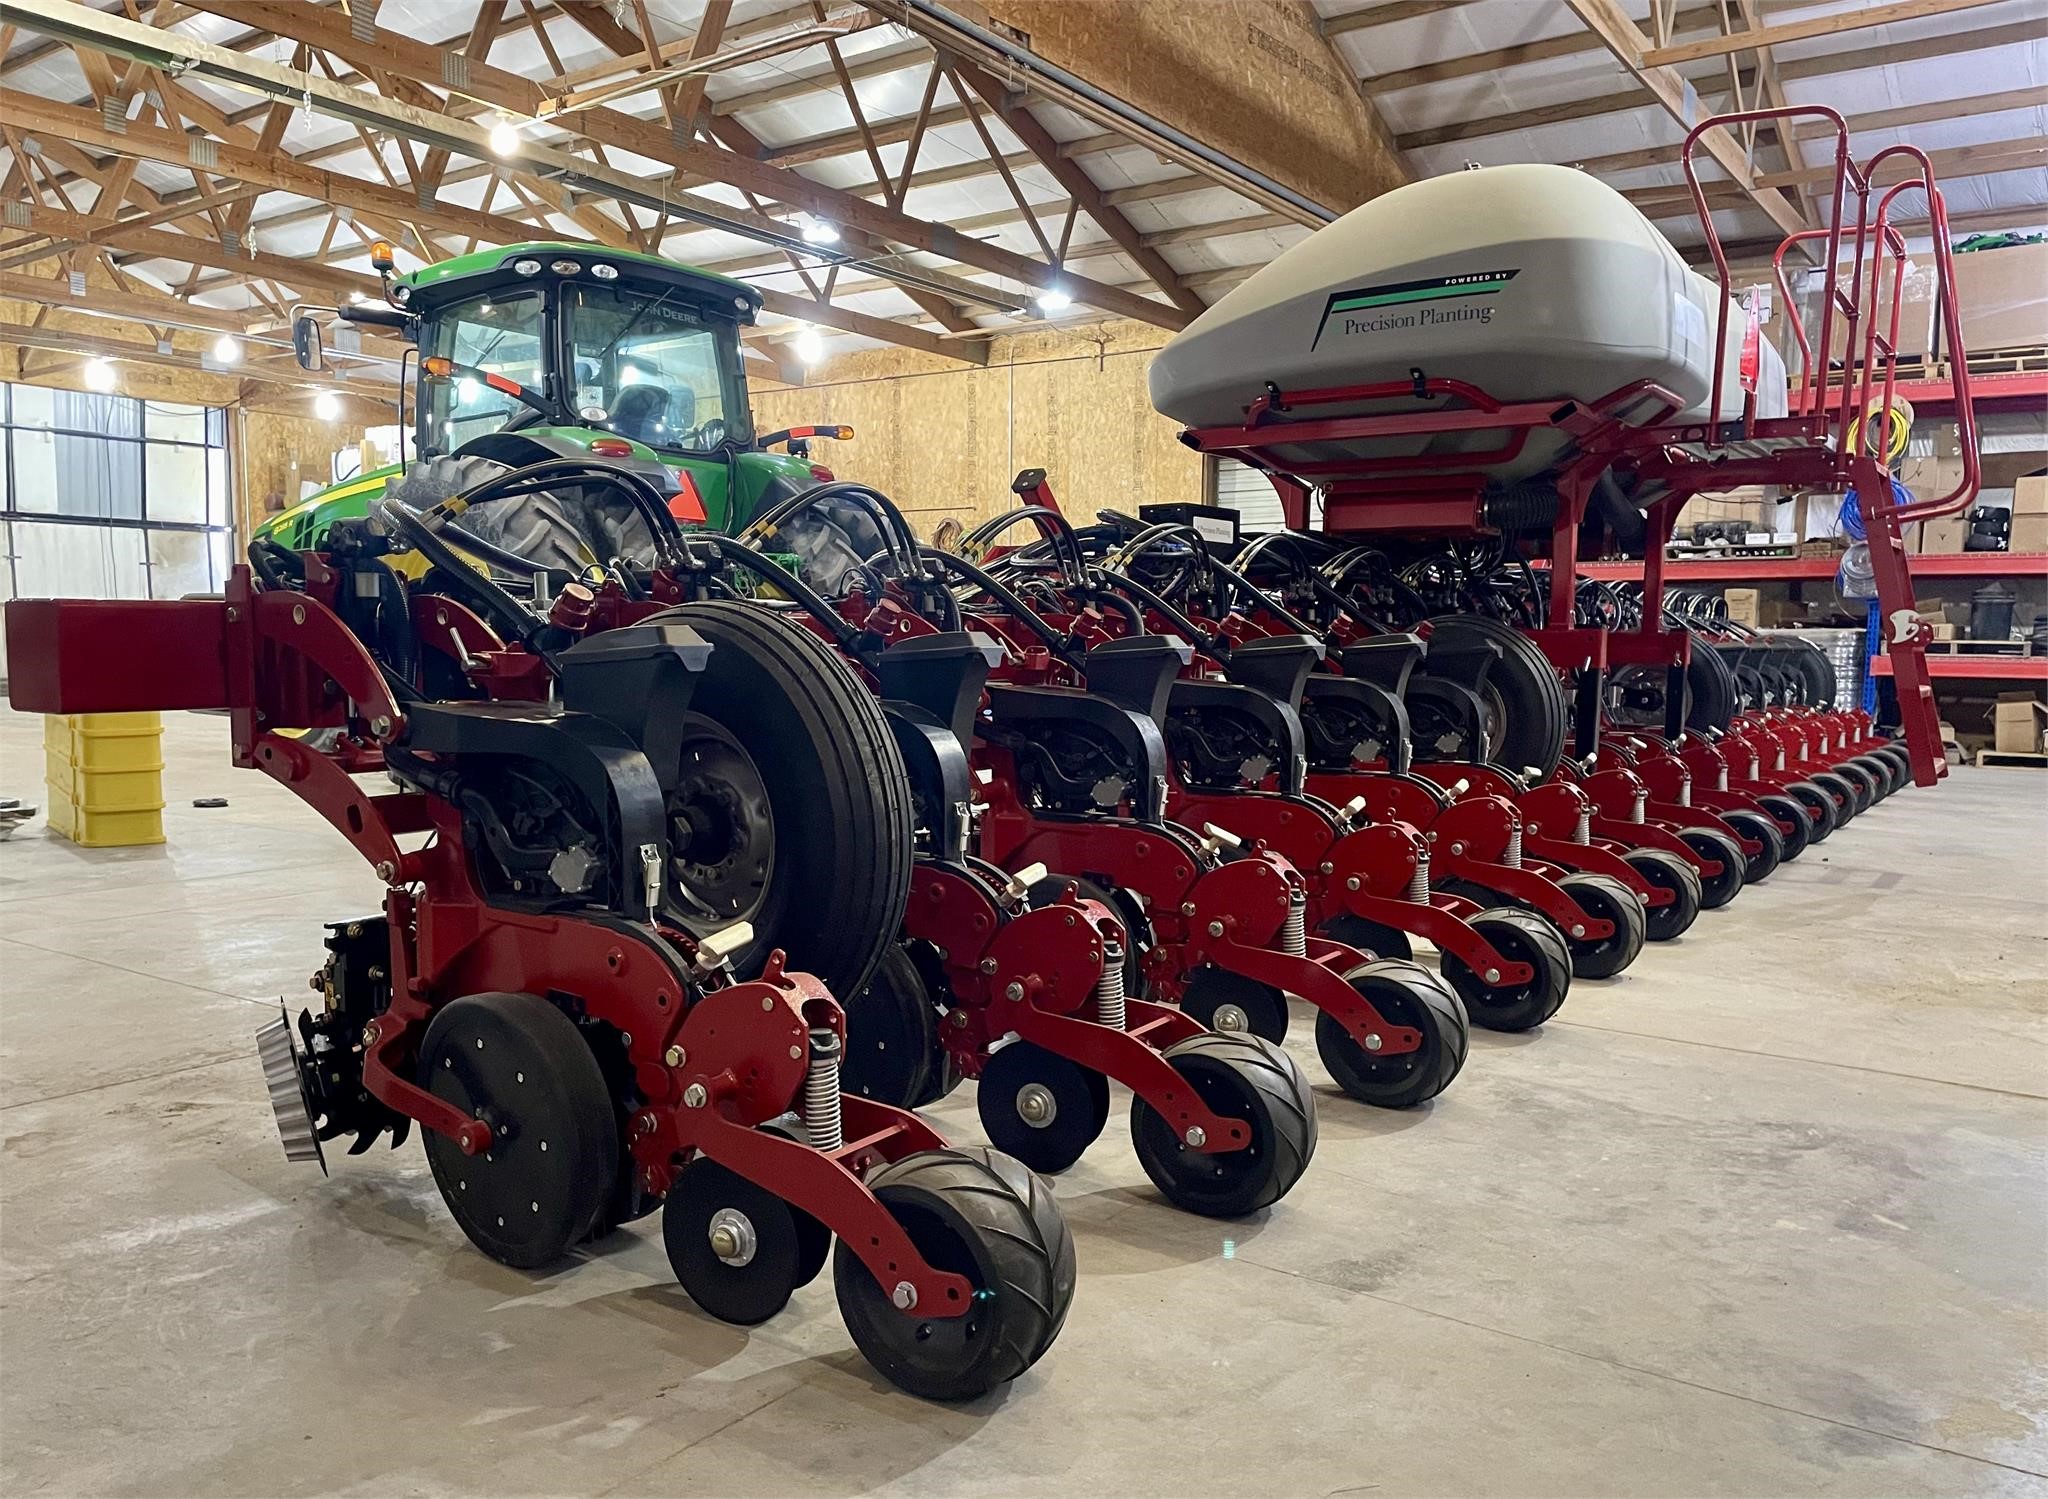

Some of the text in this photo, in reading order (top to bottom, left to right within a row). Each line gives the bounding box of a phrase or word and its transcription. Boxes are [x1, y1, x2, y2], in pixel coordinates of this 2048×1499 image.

[1445, 274, 1491, 285] POWERED
[662, 307, 698, 325] DEERE
[1345, 304, 1491, 335] Precision Planting
